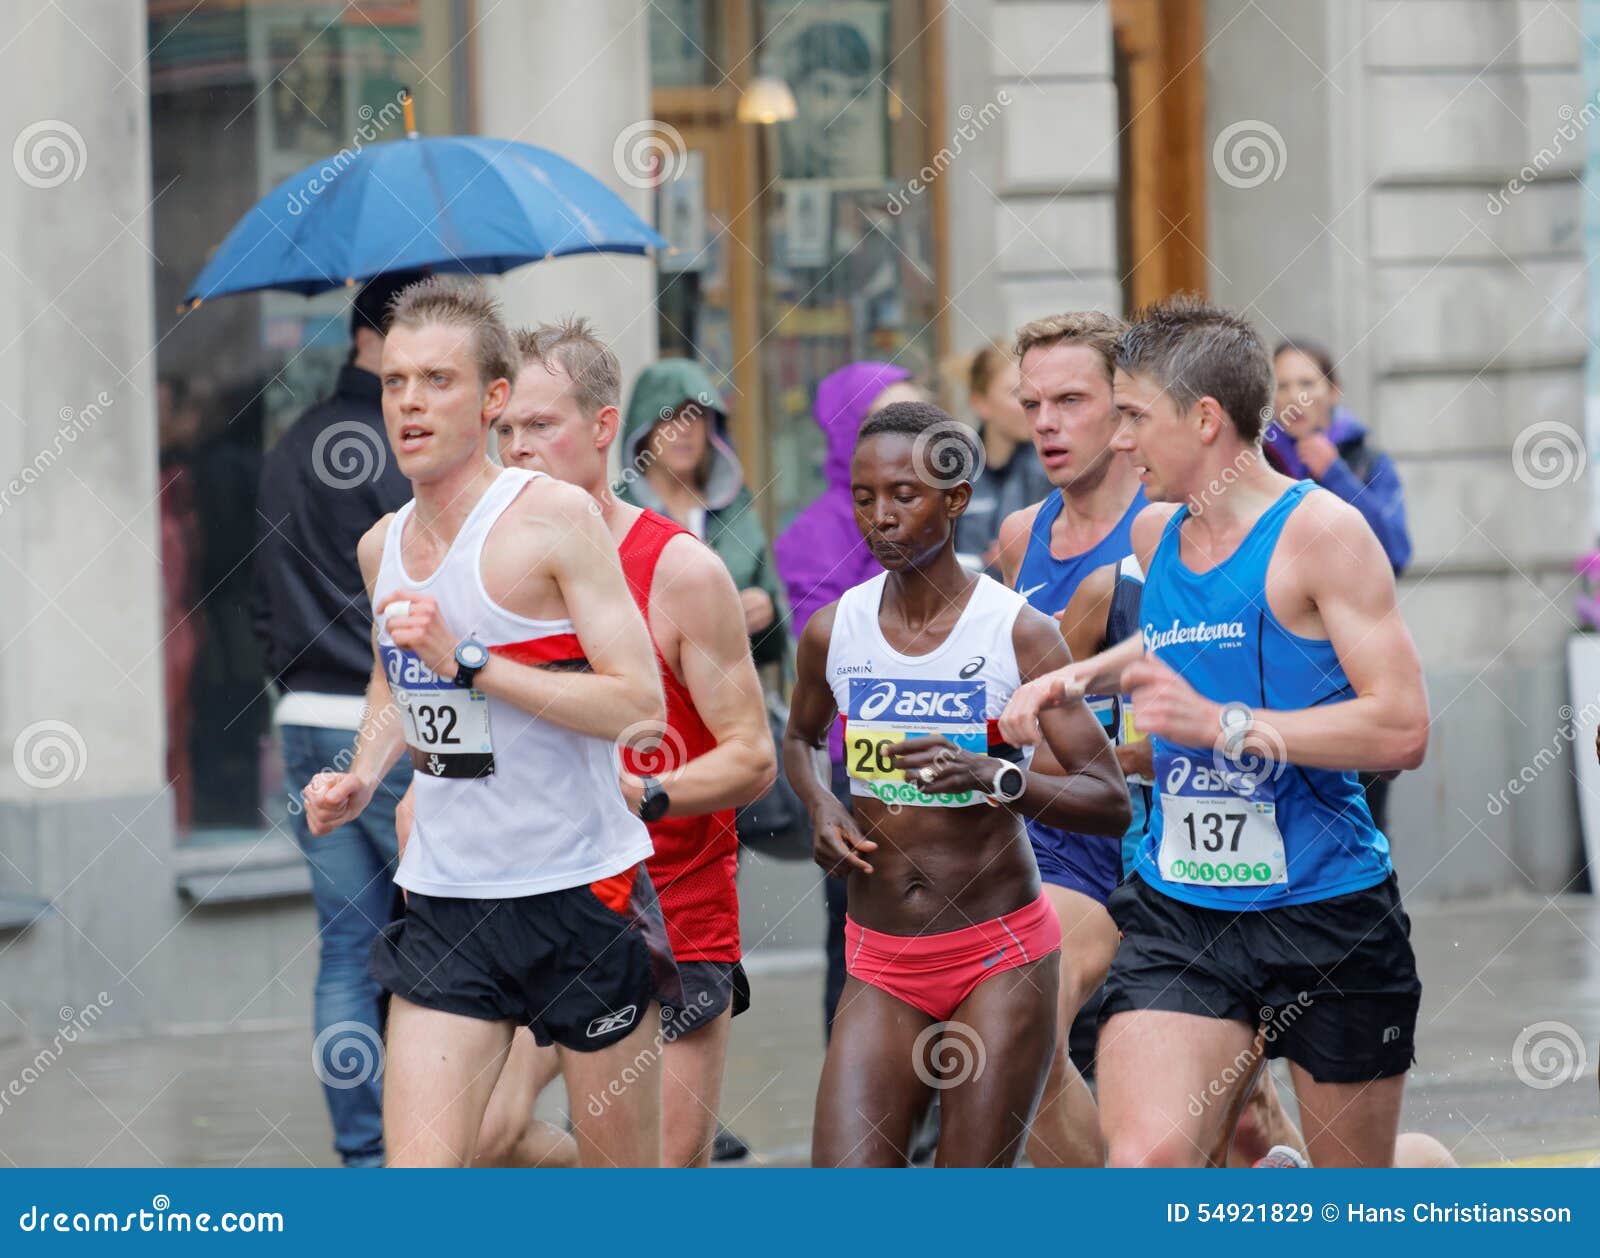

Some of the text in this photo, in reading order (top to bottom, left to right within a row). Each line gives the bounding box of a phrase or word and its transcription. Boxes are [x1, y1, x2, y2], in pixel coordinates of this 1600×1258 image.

[1143, 619, 1246, 652] Studenterna
[836, 664, 873, 676] GARMIN
[894, 690, 970, 718] asics
[408, 703, 461, 745] 132
[1192, 766, 1257, 796] asics
[1183, 812, 1248, 853] 137
[1171, 860, 1271, 882] UNIBET
